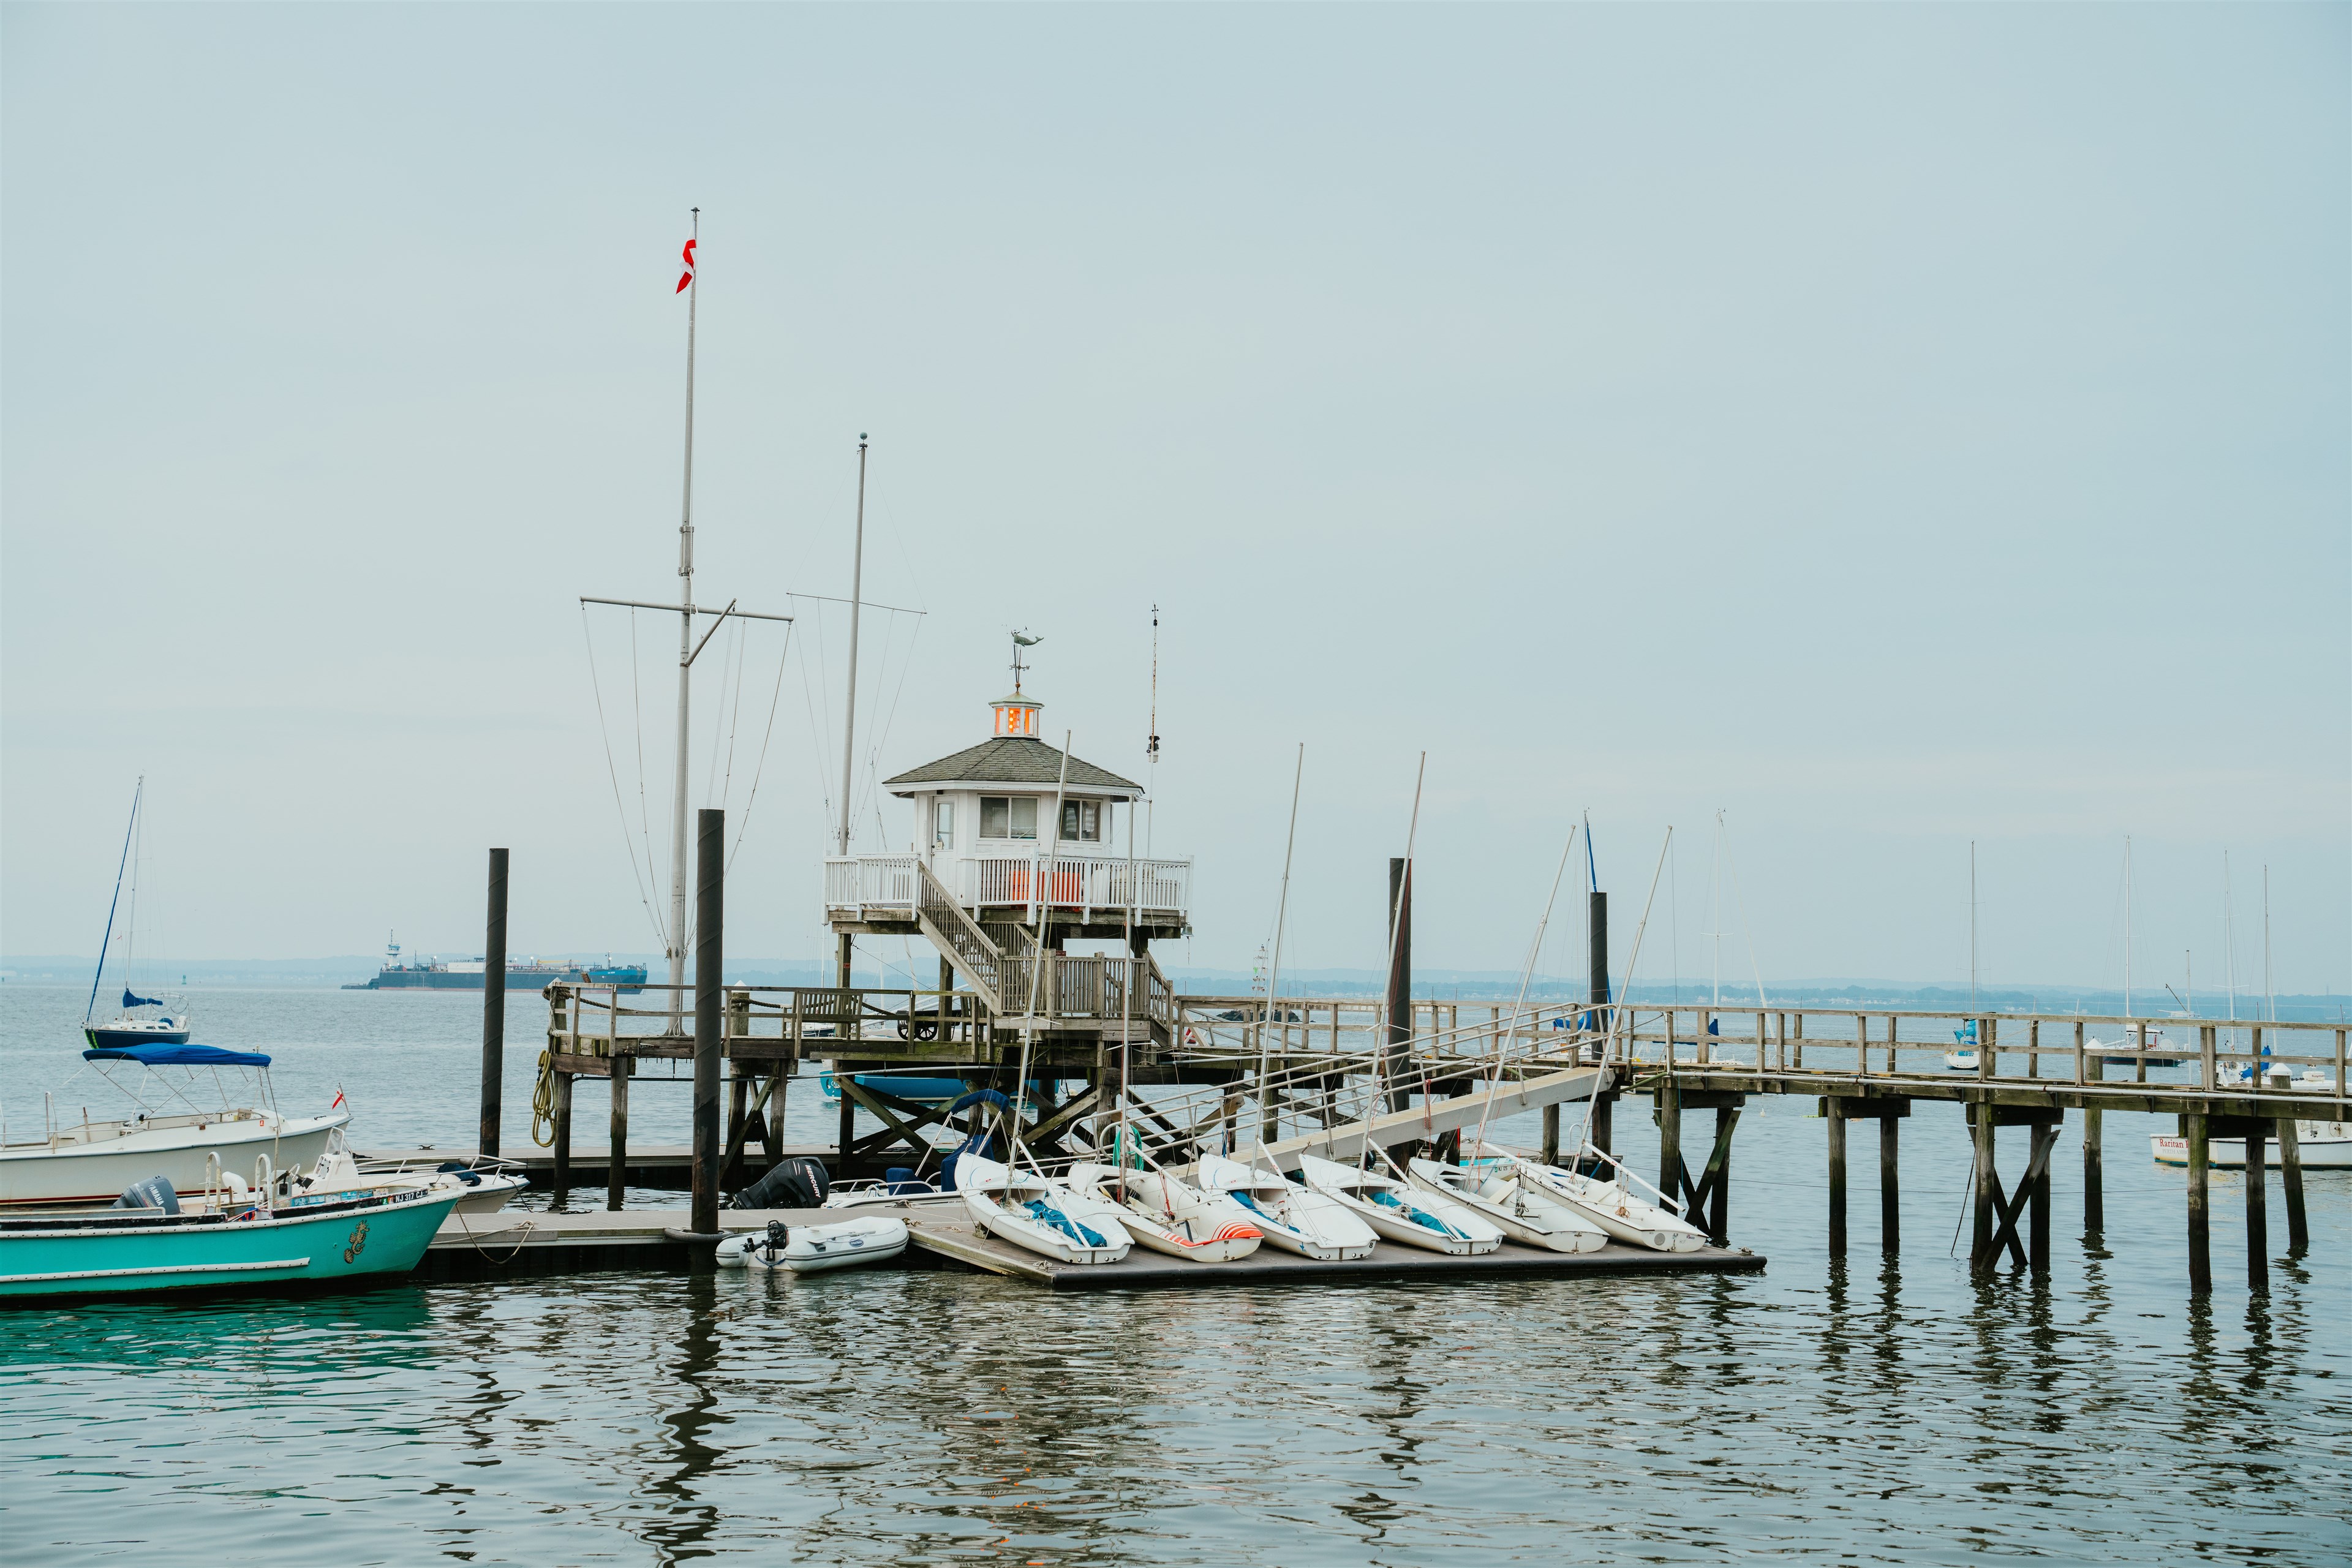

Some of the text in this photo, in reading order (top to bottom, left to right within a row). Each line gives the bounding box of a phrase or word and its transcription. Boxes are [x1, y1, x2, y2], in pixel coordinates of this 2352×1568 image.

[2159, 1138, 2184, 1148] Raritan
[805, 1164, 821, 1198] MERCURY
[148, 1184, 165, 1206] YAMAHA
[405, 1193, 414, 1201] 317
